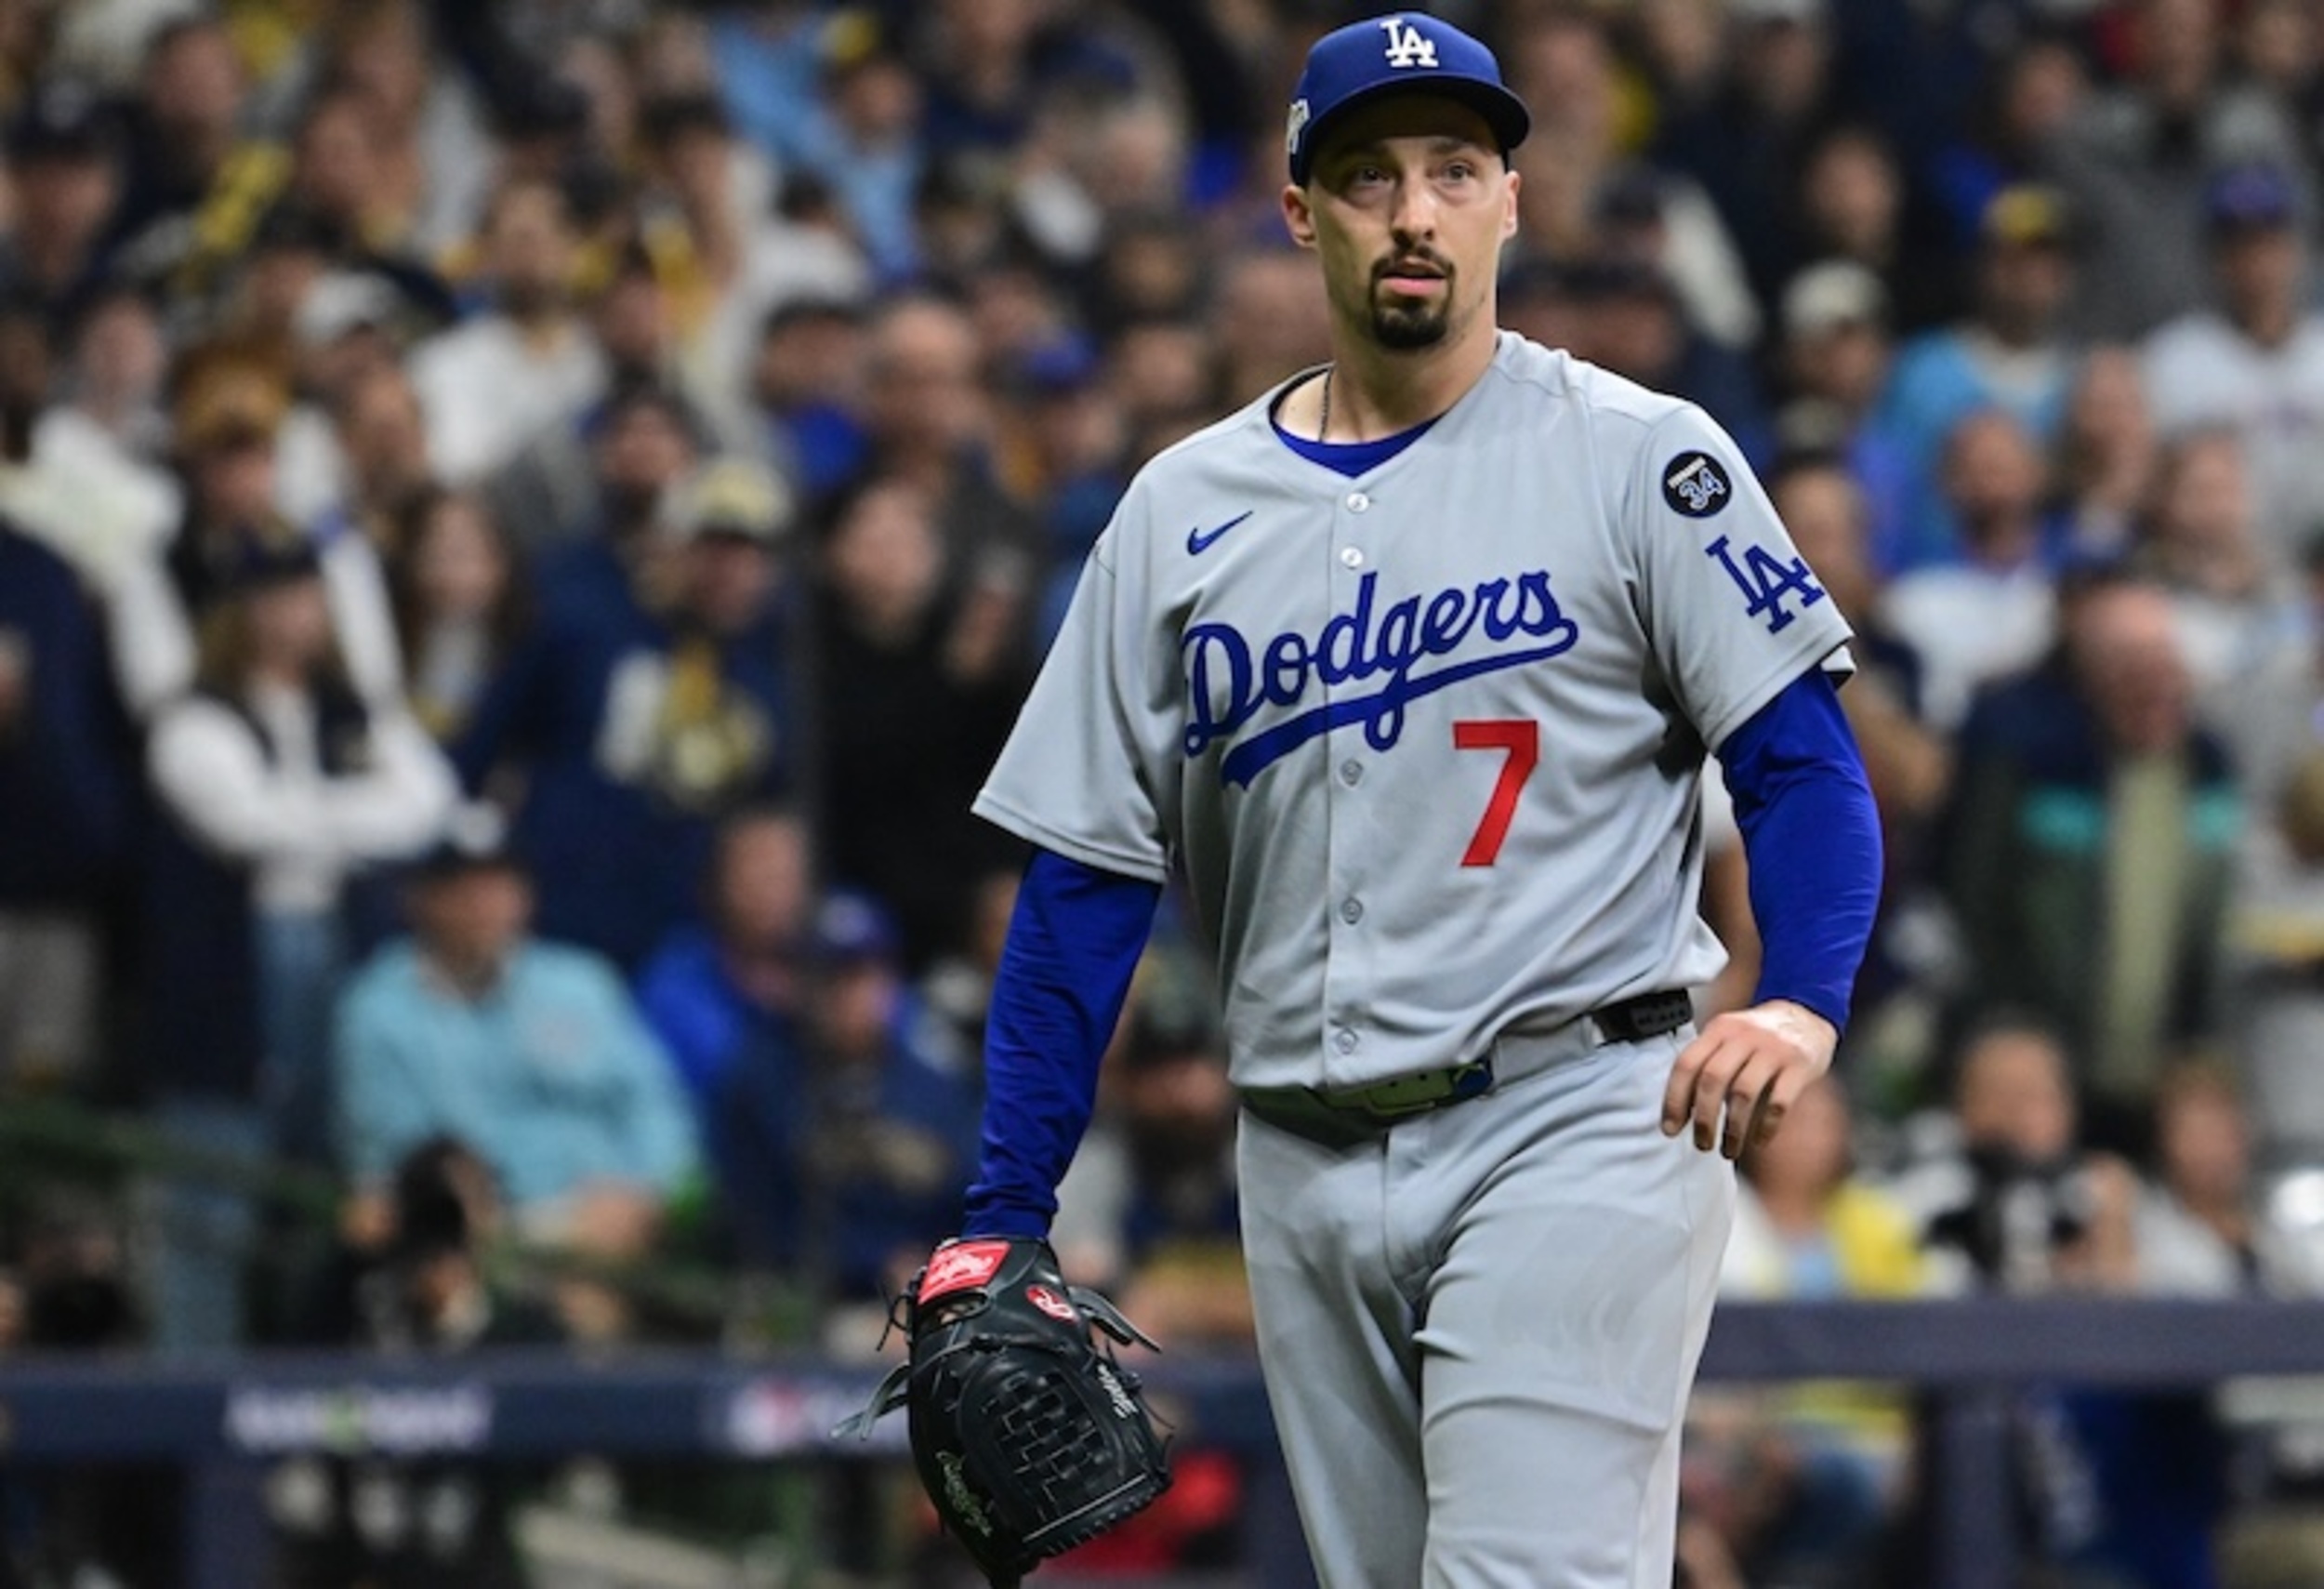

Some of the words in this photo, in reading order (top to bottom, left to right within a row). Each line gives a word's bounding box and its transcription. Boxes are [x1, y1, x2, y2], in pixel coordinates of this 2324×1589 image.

[1380, 19, 1439, 67] LA
[1679, 467, 1726, 510] 34
[1704, 534, 1826, 635] LA
[1182, 570, 1578, 790] Dodgers
[1452, 719, 1539, 867] 7
